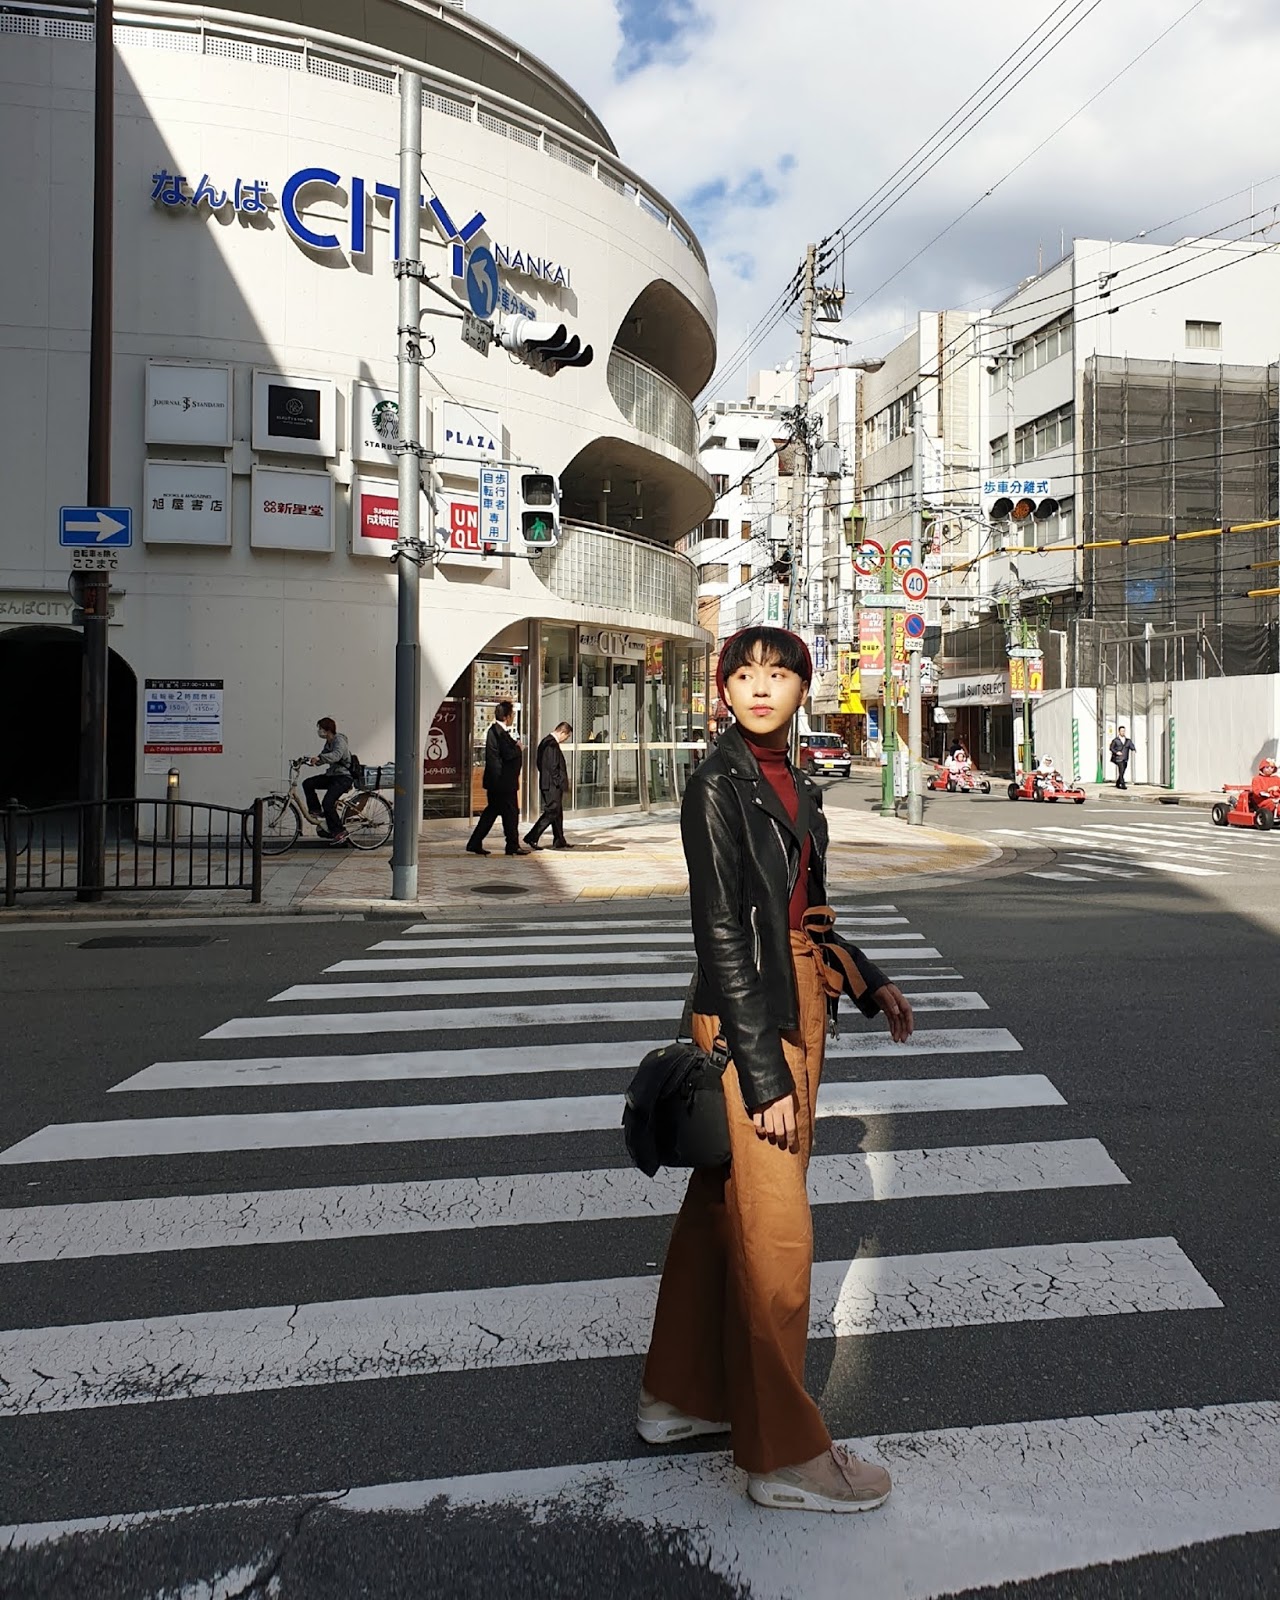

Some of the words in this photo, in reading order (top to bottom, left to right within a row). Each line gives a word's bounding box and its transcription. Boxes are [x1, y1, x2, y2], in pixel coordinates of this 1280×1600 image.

[151, 169, 269, 212] なんば
[495, 242, 571, 288] NANKAI
[364, 440, 399, 450] STARB
[446, 429, 495, 450] PLAZA
[484, 473, 494, 509] 自転車
[496, 473, 506, 510] 歩行者
[984, 480, 1048, 494] 歩車分離式
[152, 498, 222, 511] 旭屋書店
[277, 502, 324, 517] 新星堂
[366, 514, 399, 528] 成城石
[455, 508, 478, 528] UN
[489, 513, 499, 538] 専用
[455, 529, 481, 548] QL
[73, 549, 117, 558] 自転車を除く
[73, 559, 118, 569] ここまで
[909, 577, 922, 592] 40
[599, 631, 629, 655] CITY
[982, 682, 1006, 695] SELECT
